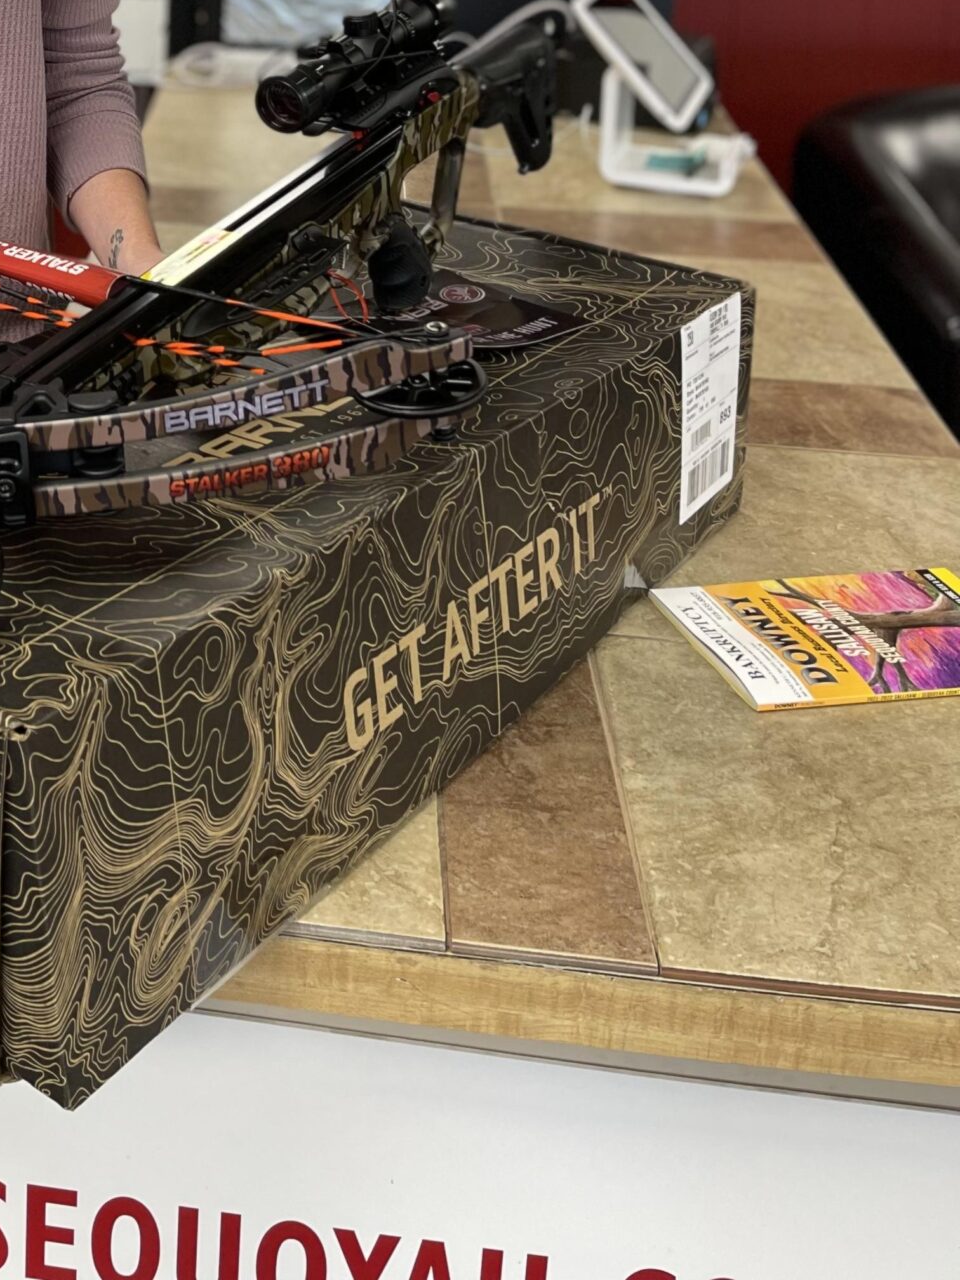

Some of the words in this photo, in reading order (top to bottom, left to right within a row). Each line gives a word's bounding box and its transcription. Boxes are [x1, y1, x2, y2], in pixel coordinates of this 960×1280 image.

[4, 246, 89, 275] STALKER
[164, 379, 329, 434] BARNETT
[169, 463, 269, 497] STALKER
[272, 443, 332, 477] 380
[343, 623, 427, 752] GET
[442, 527, 563, 681] AFTER
[564, 492, 602, 575] IT
[759, 597, 794, 625] Directory
[788, 608, 871, 657] SALLISAW
[814, 599, 860, 625] COUNTY
[680, 606, 766, 680] BANKRUPTCY
[721, 596, 839, 686] DOWNEY
[790, 625, 828, 654] Business
[821, 650, 848, 673] Local
[847, 624, 907, 663] SEQUOYAH
